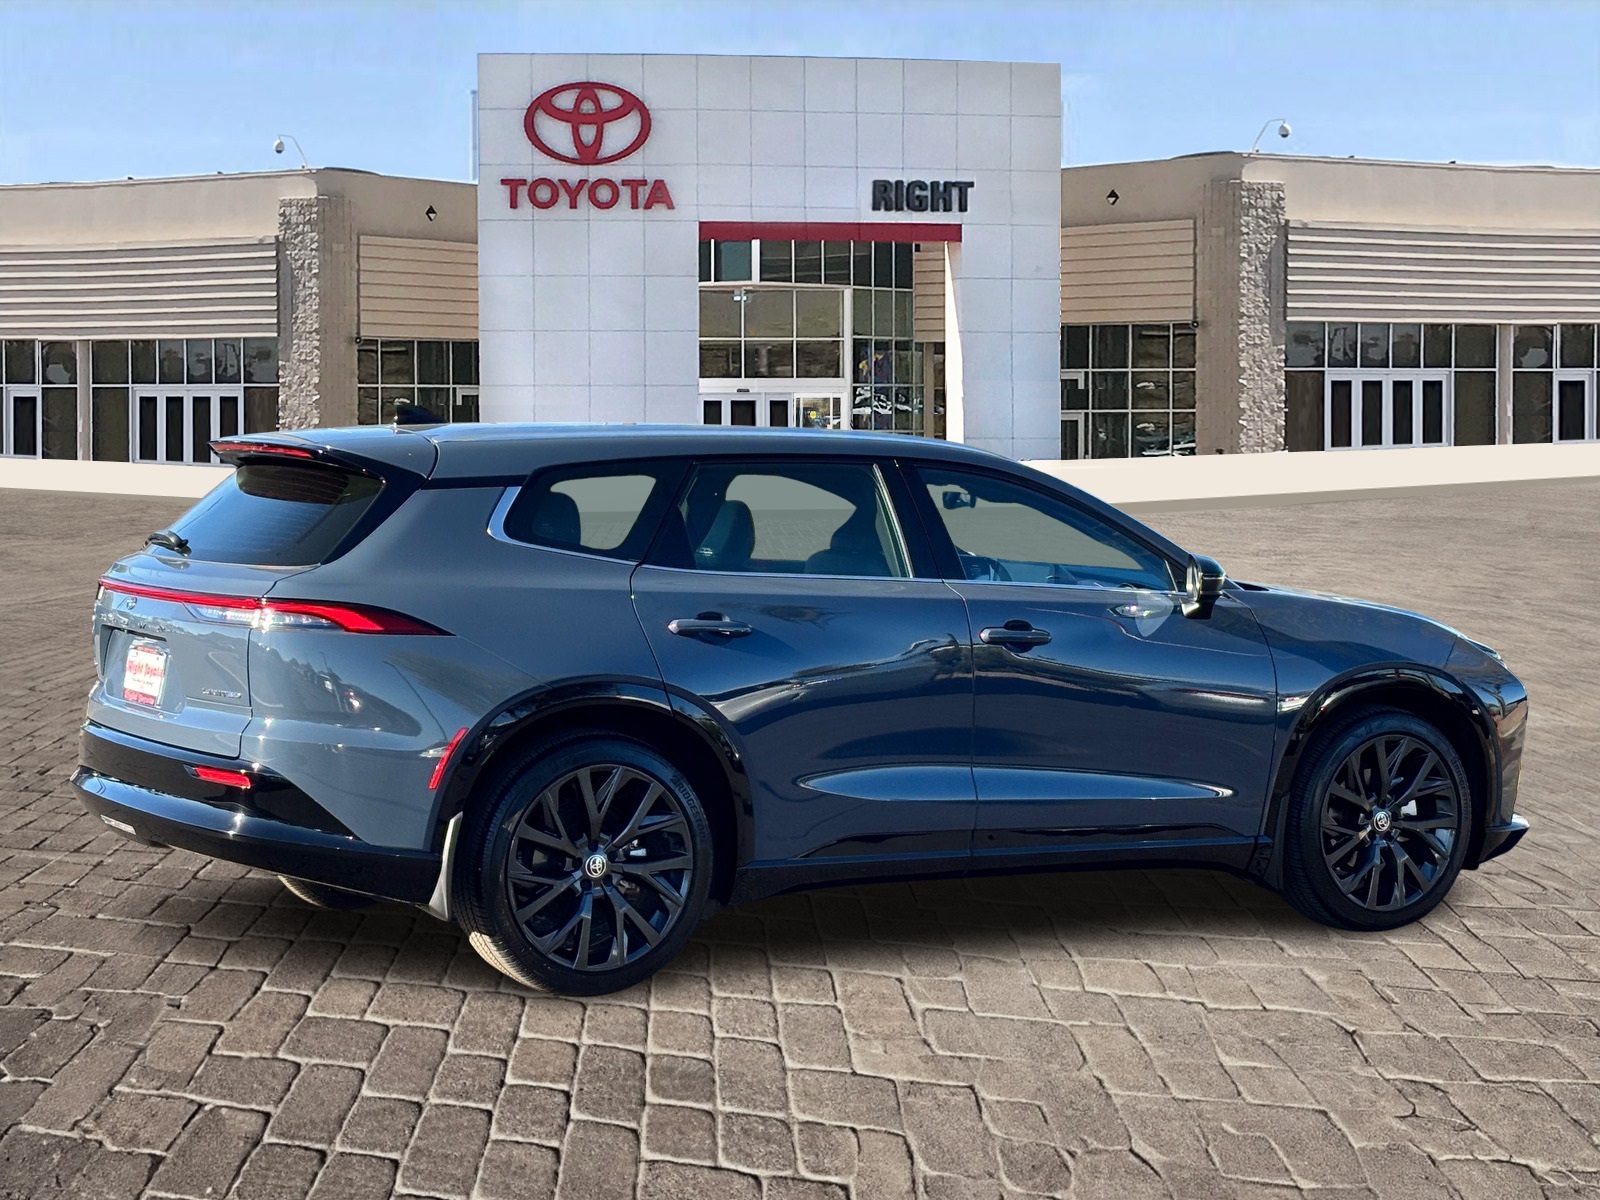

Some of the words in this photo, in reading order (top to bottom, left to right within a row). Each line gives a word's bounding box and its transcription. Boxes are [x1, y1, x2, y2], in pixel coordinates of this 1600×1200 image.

[500, 177, 675, 210] TOYOTA
[872, 179, 975, 212] RIGHT
[669, 775, 707, 841] BRIDGESTON
